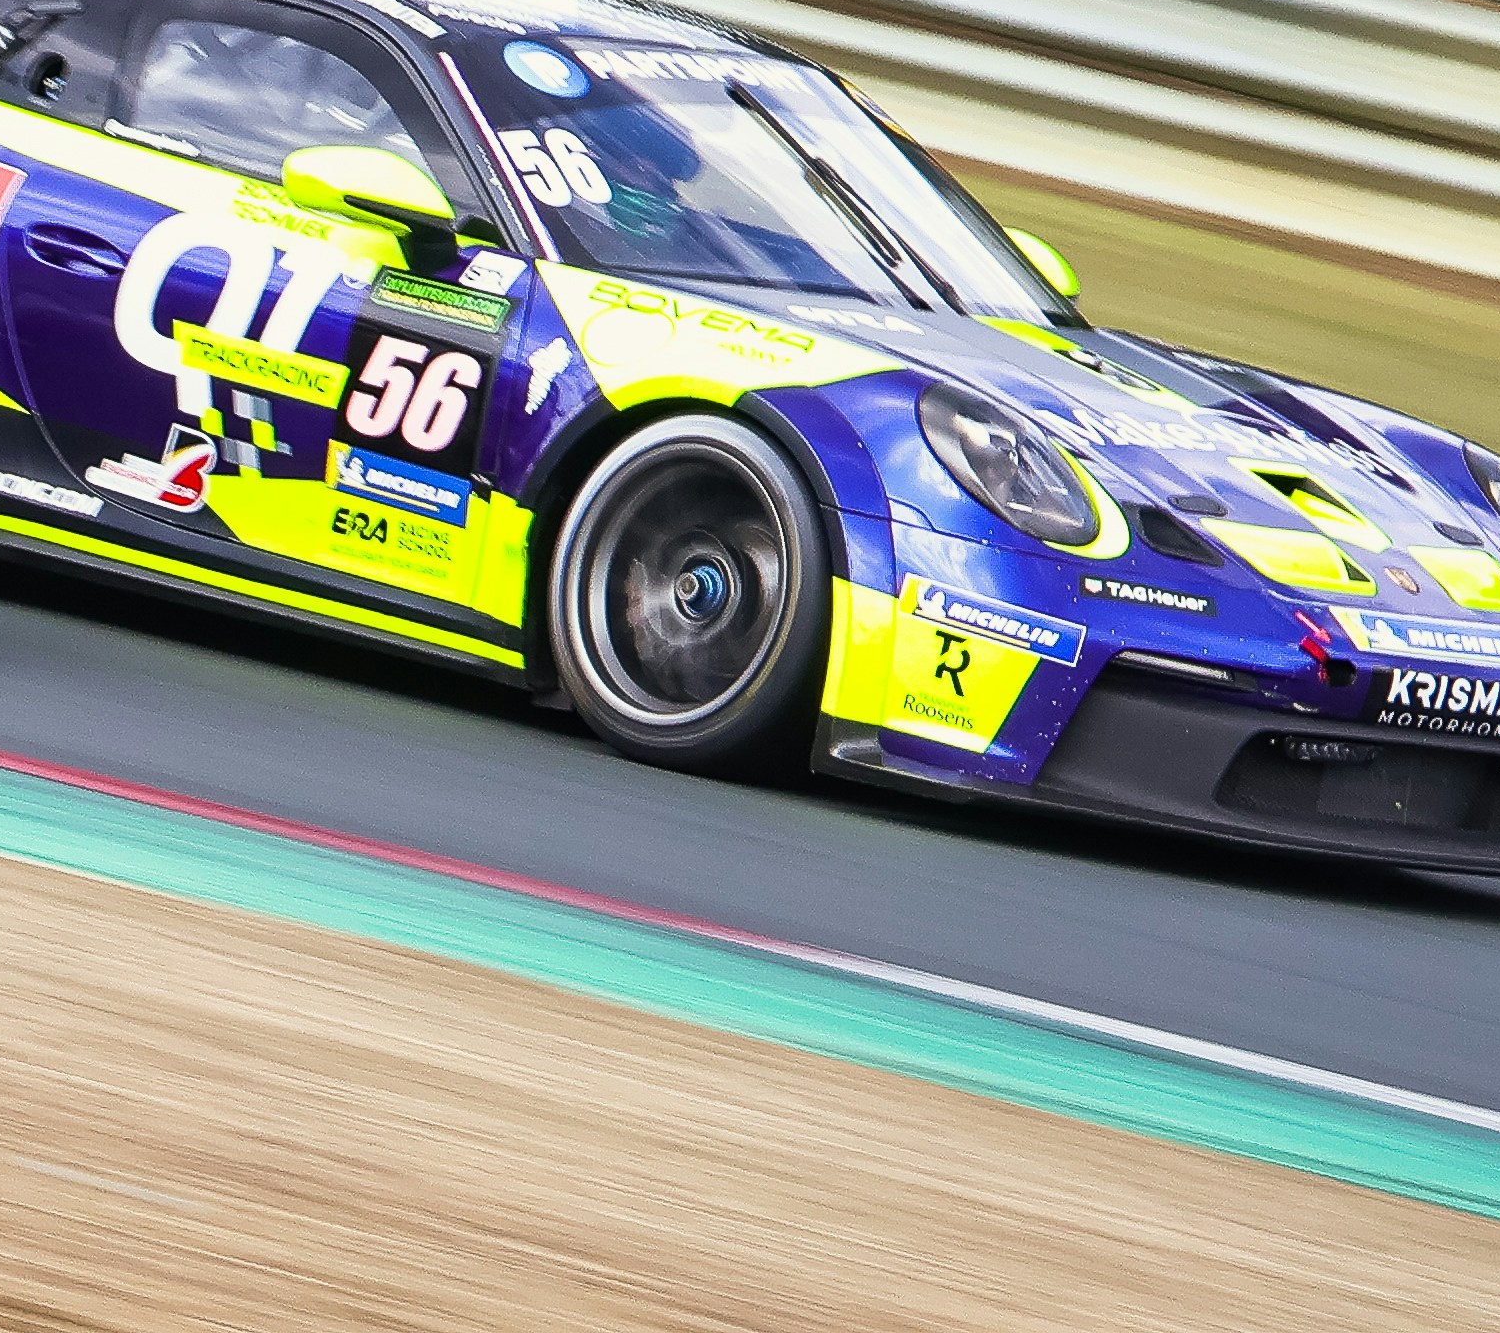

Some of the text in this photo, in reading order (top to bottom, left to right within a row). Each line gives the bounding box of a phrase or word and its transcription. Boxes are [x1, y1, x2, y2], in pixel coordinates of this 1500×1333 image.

[498, 127, 613, 208] 56
[588, 279, 815, 353] BOVEMA
[345, 334, 483, 452] 56
[365, 467, 462, 509] MICHELIN
[331, 506, 388, 544] ERA
[399, 520, 450, 545] RACING
[947, 602, 1060, 648] MICHELIN
[903, 693, 974, 731] Roosens
